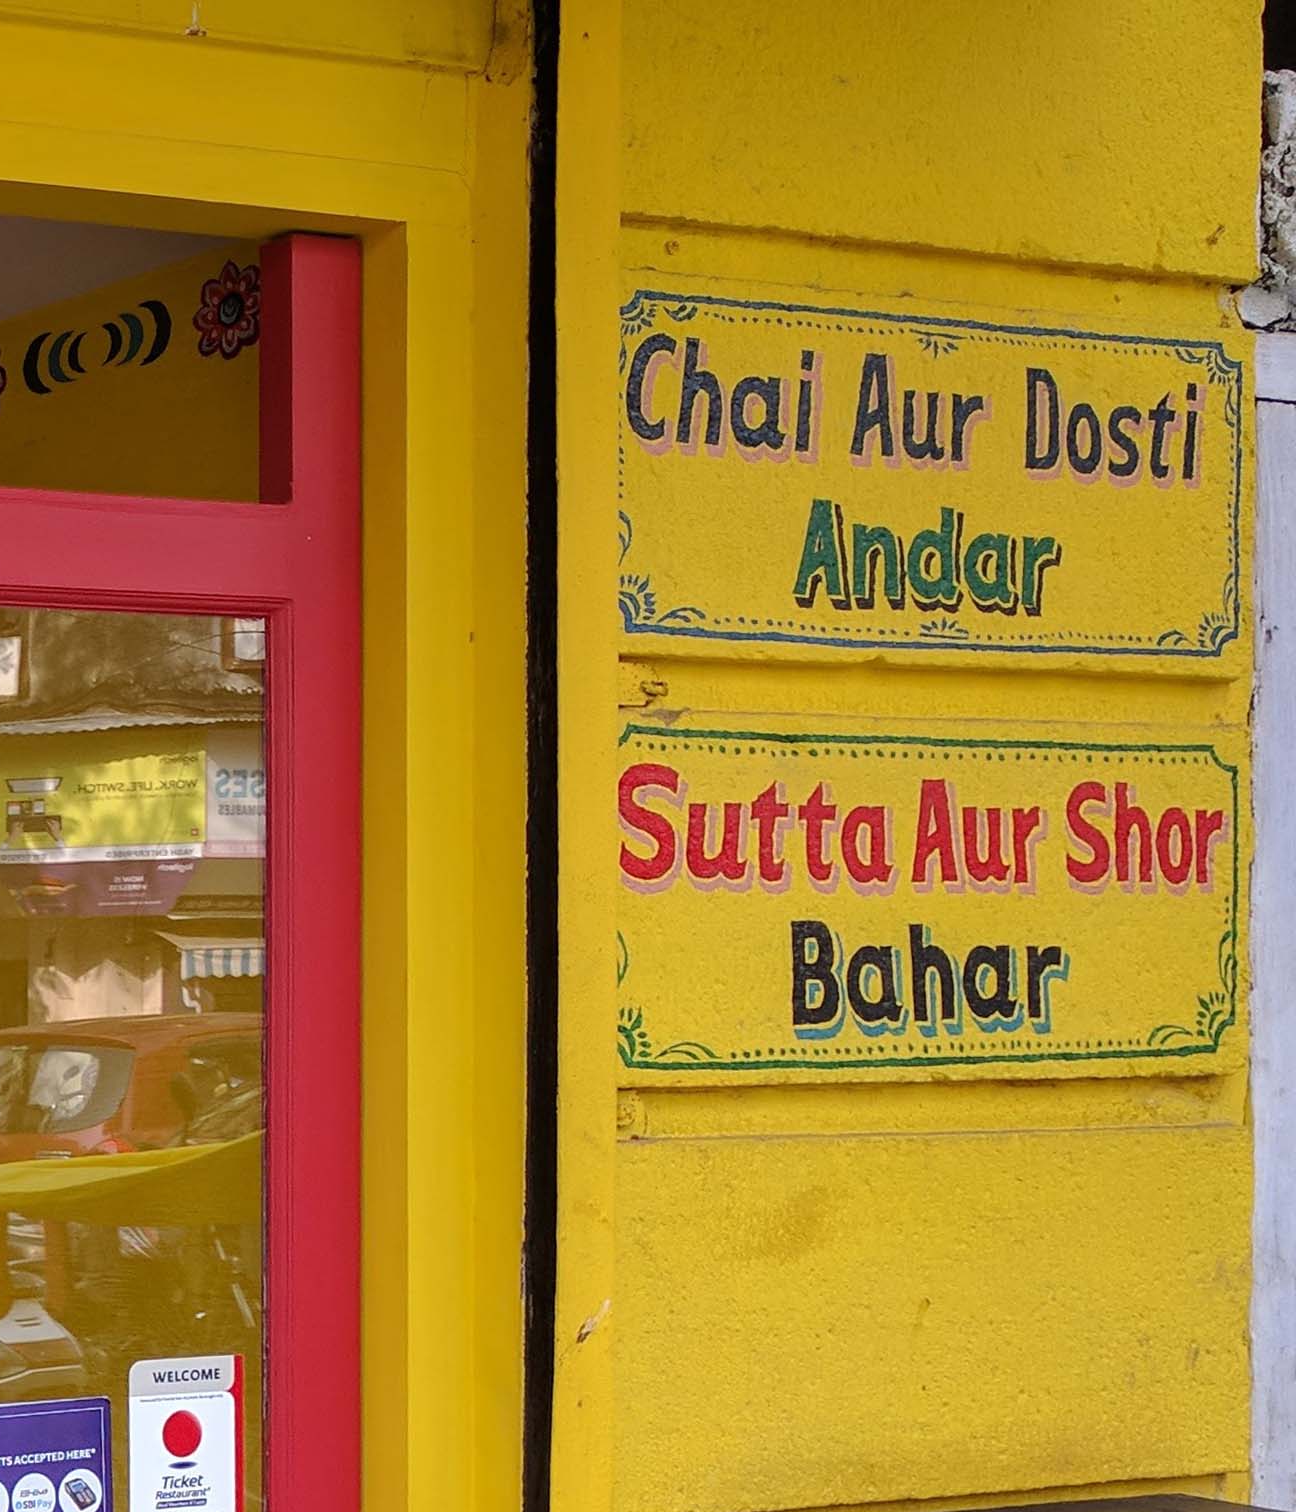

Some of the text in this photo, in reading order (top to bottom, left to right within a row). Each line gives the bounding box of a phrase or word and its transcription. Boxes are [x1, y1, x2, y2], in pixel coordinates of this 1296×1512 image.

[625, 334, 1204, 487] Chai Aur Dosti
[794, 499, 1063, 615] Andar
[618, 763, 1229, 893] Sutta Aur Shor
[791, 920, 1069, 1038] Bahar
[152, 1368, 221, 1384] WELCOME
[13, 1451, 65, 1467] ACCEPTED
[161, 1474, 204, 1490] Ticket
